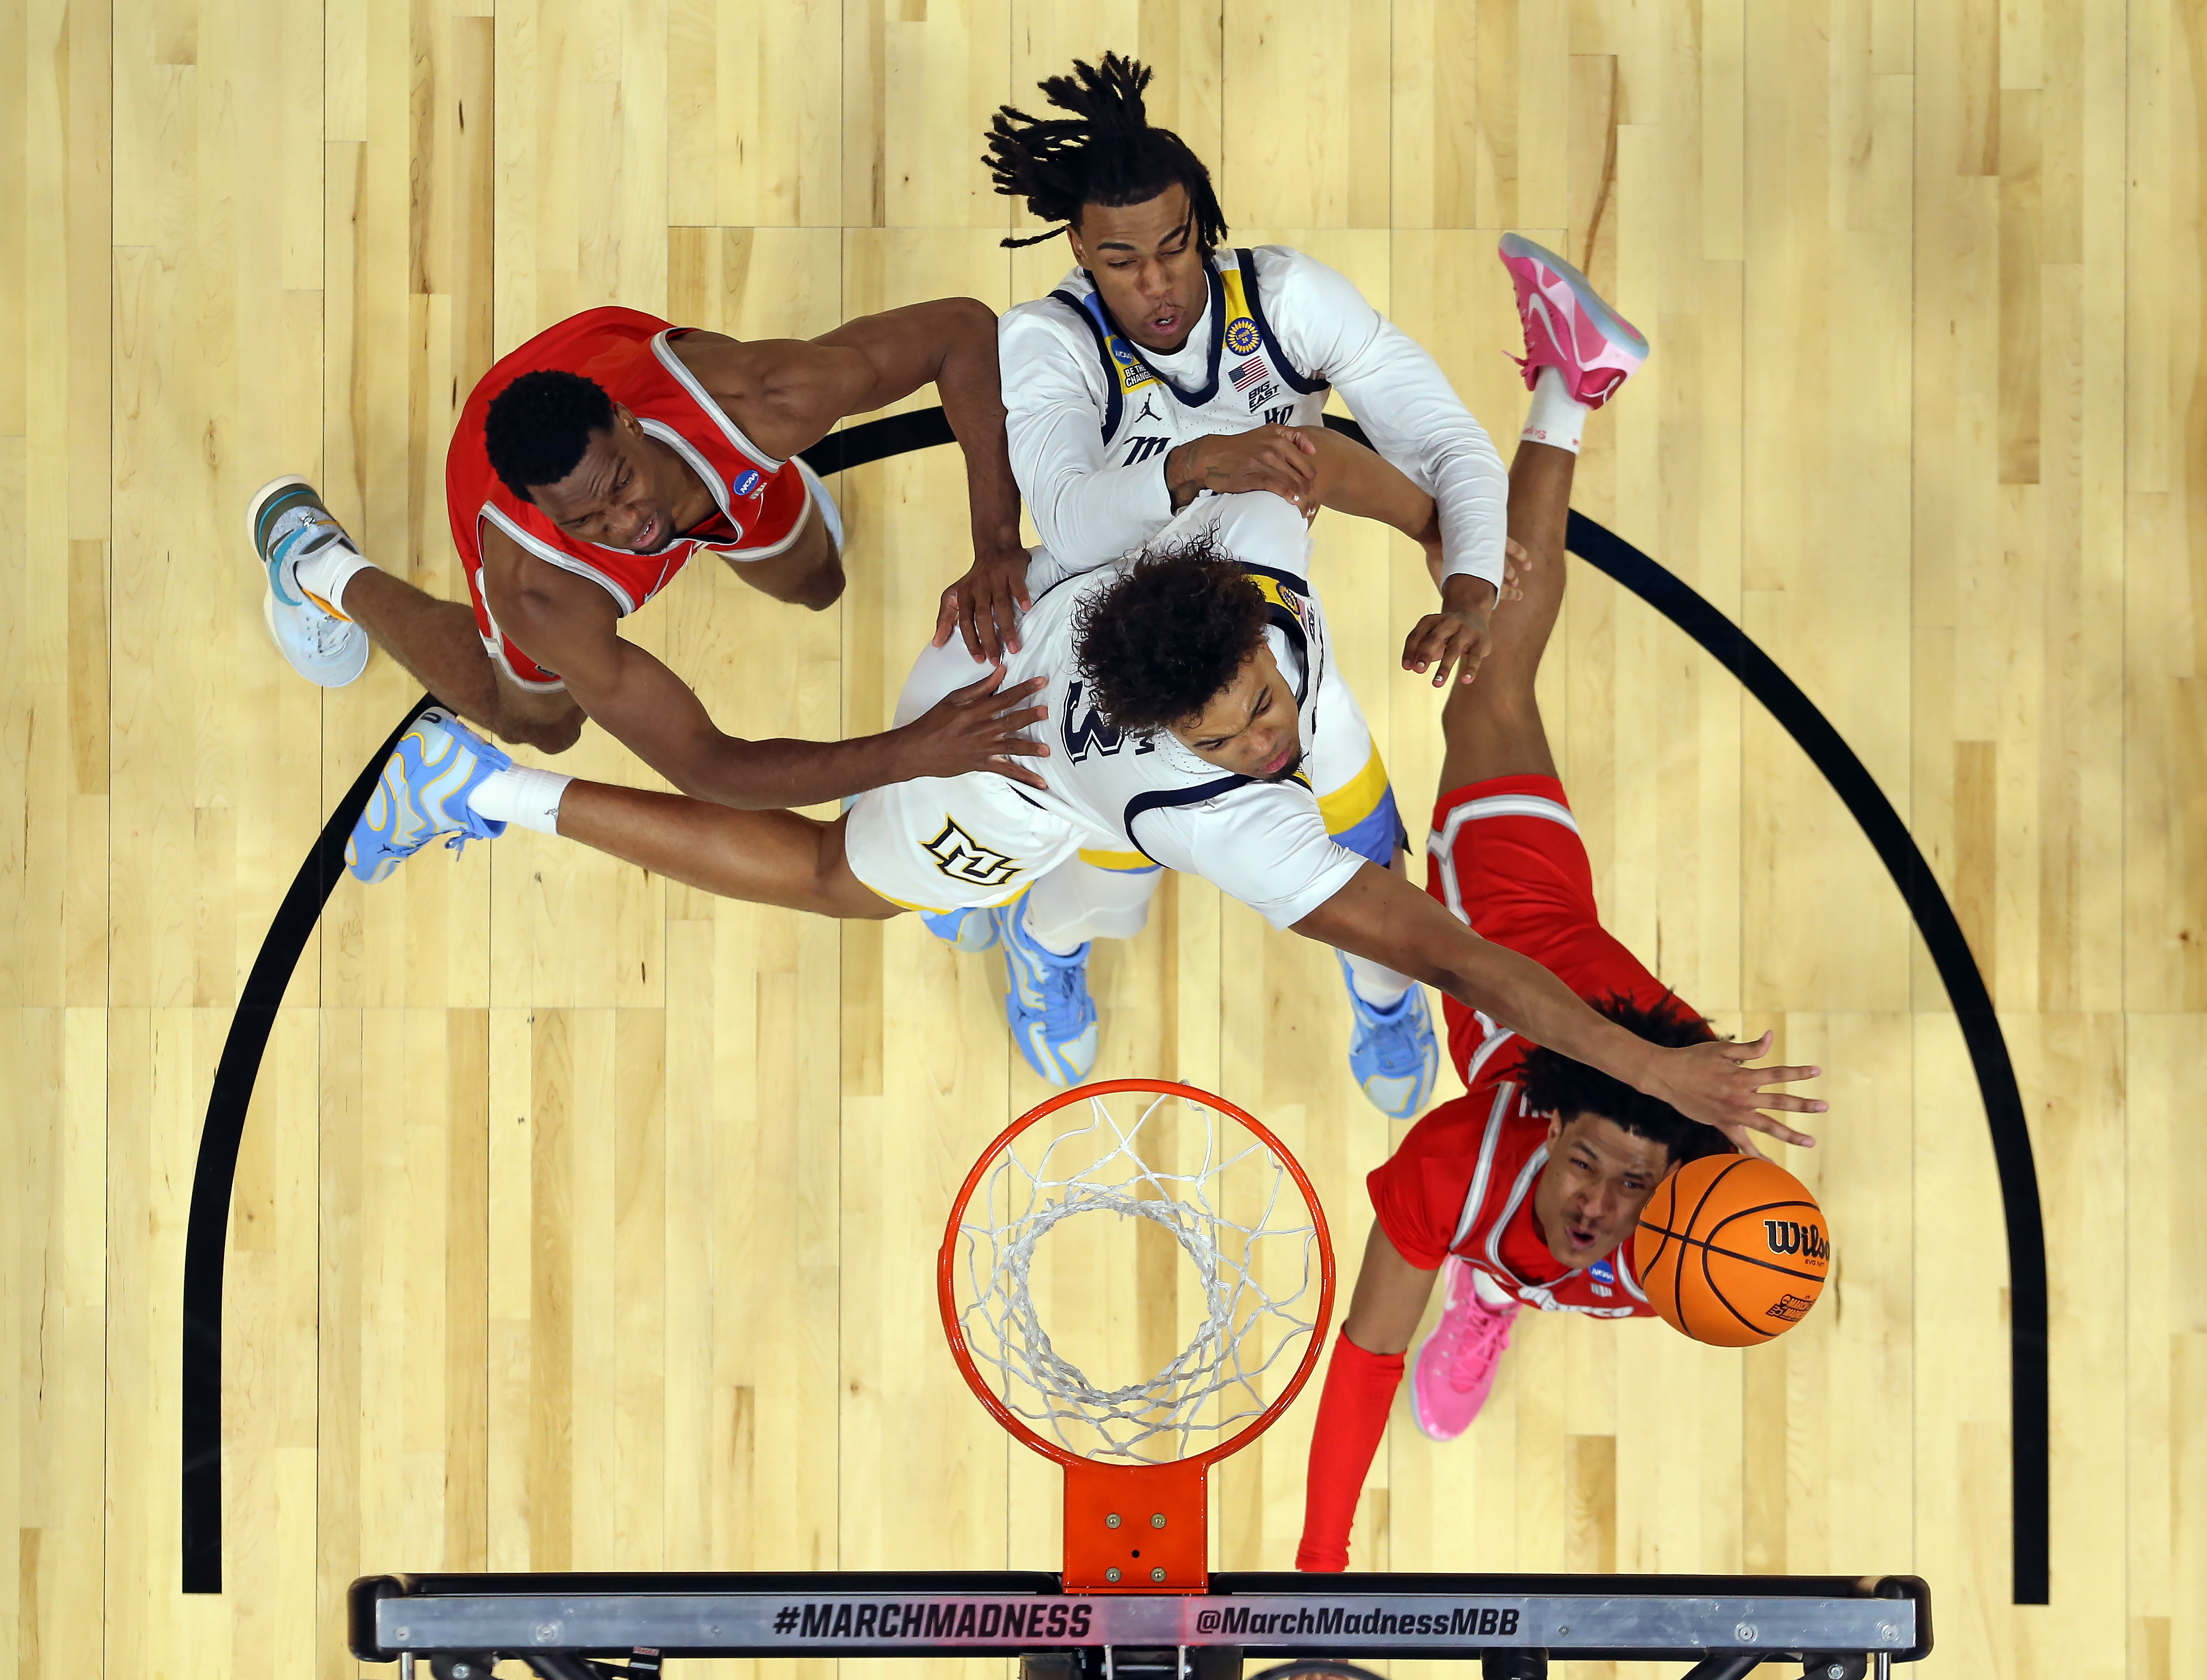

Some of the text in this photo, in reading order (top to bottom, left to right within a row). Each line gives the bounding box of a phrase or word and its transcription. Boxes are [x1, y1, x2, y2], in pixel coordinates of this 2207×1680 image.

[1125, 367, 1136, 377] BE
[1126, 371, 1152, 386] CHANGE
[1249, 381, 1270, 400] BIG
[1249, 384, 1280, 409] EAST
[740, 473, 758, 493] NCAA
[1763, 1219, 1830, 1261] Wilso
[1591, 1267, 1614, 1281] NCAA
[772, 1604, 1520, 1638] #MARCHMADNESS @MarchMadnessMBB
